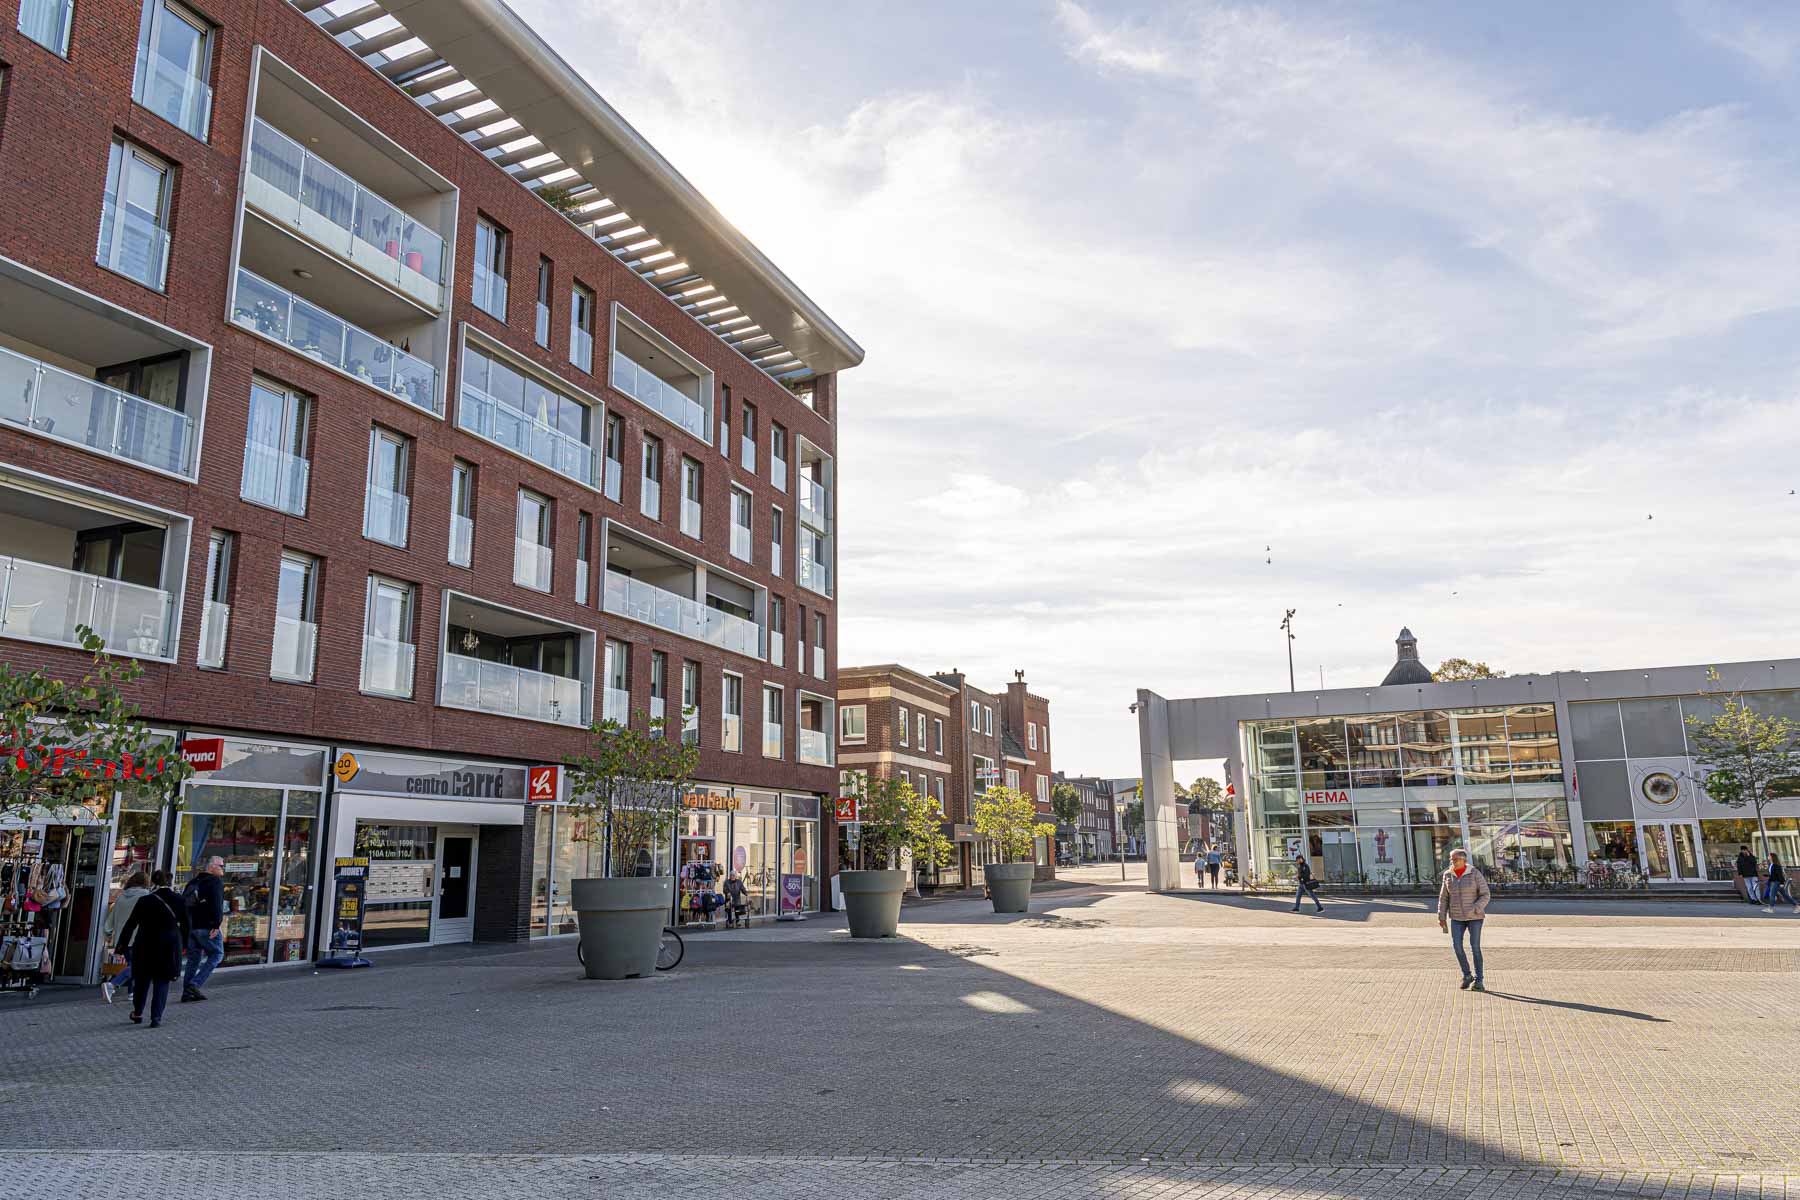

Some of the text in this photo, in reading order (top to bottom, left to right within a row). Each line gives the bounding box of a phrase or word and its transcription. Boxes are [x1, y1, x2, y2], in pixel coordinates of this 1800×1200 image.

[182, 749, 216, 762] bruna
[406, 768, 504, 798] centro Carré
[1305, 791, 1348, 804] HEMA
[340, 867, 364, 876] MONEY
